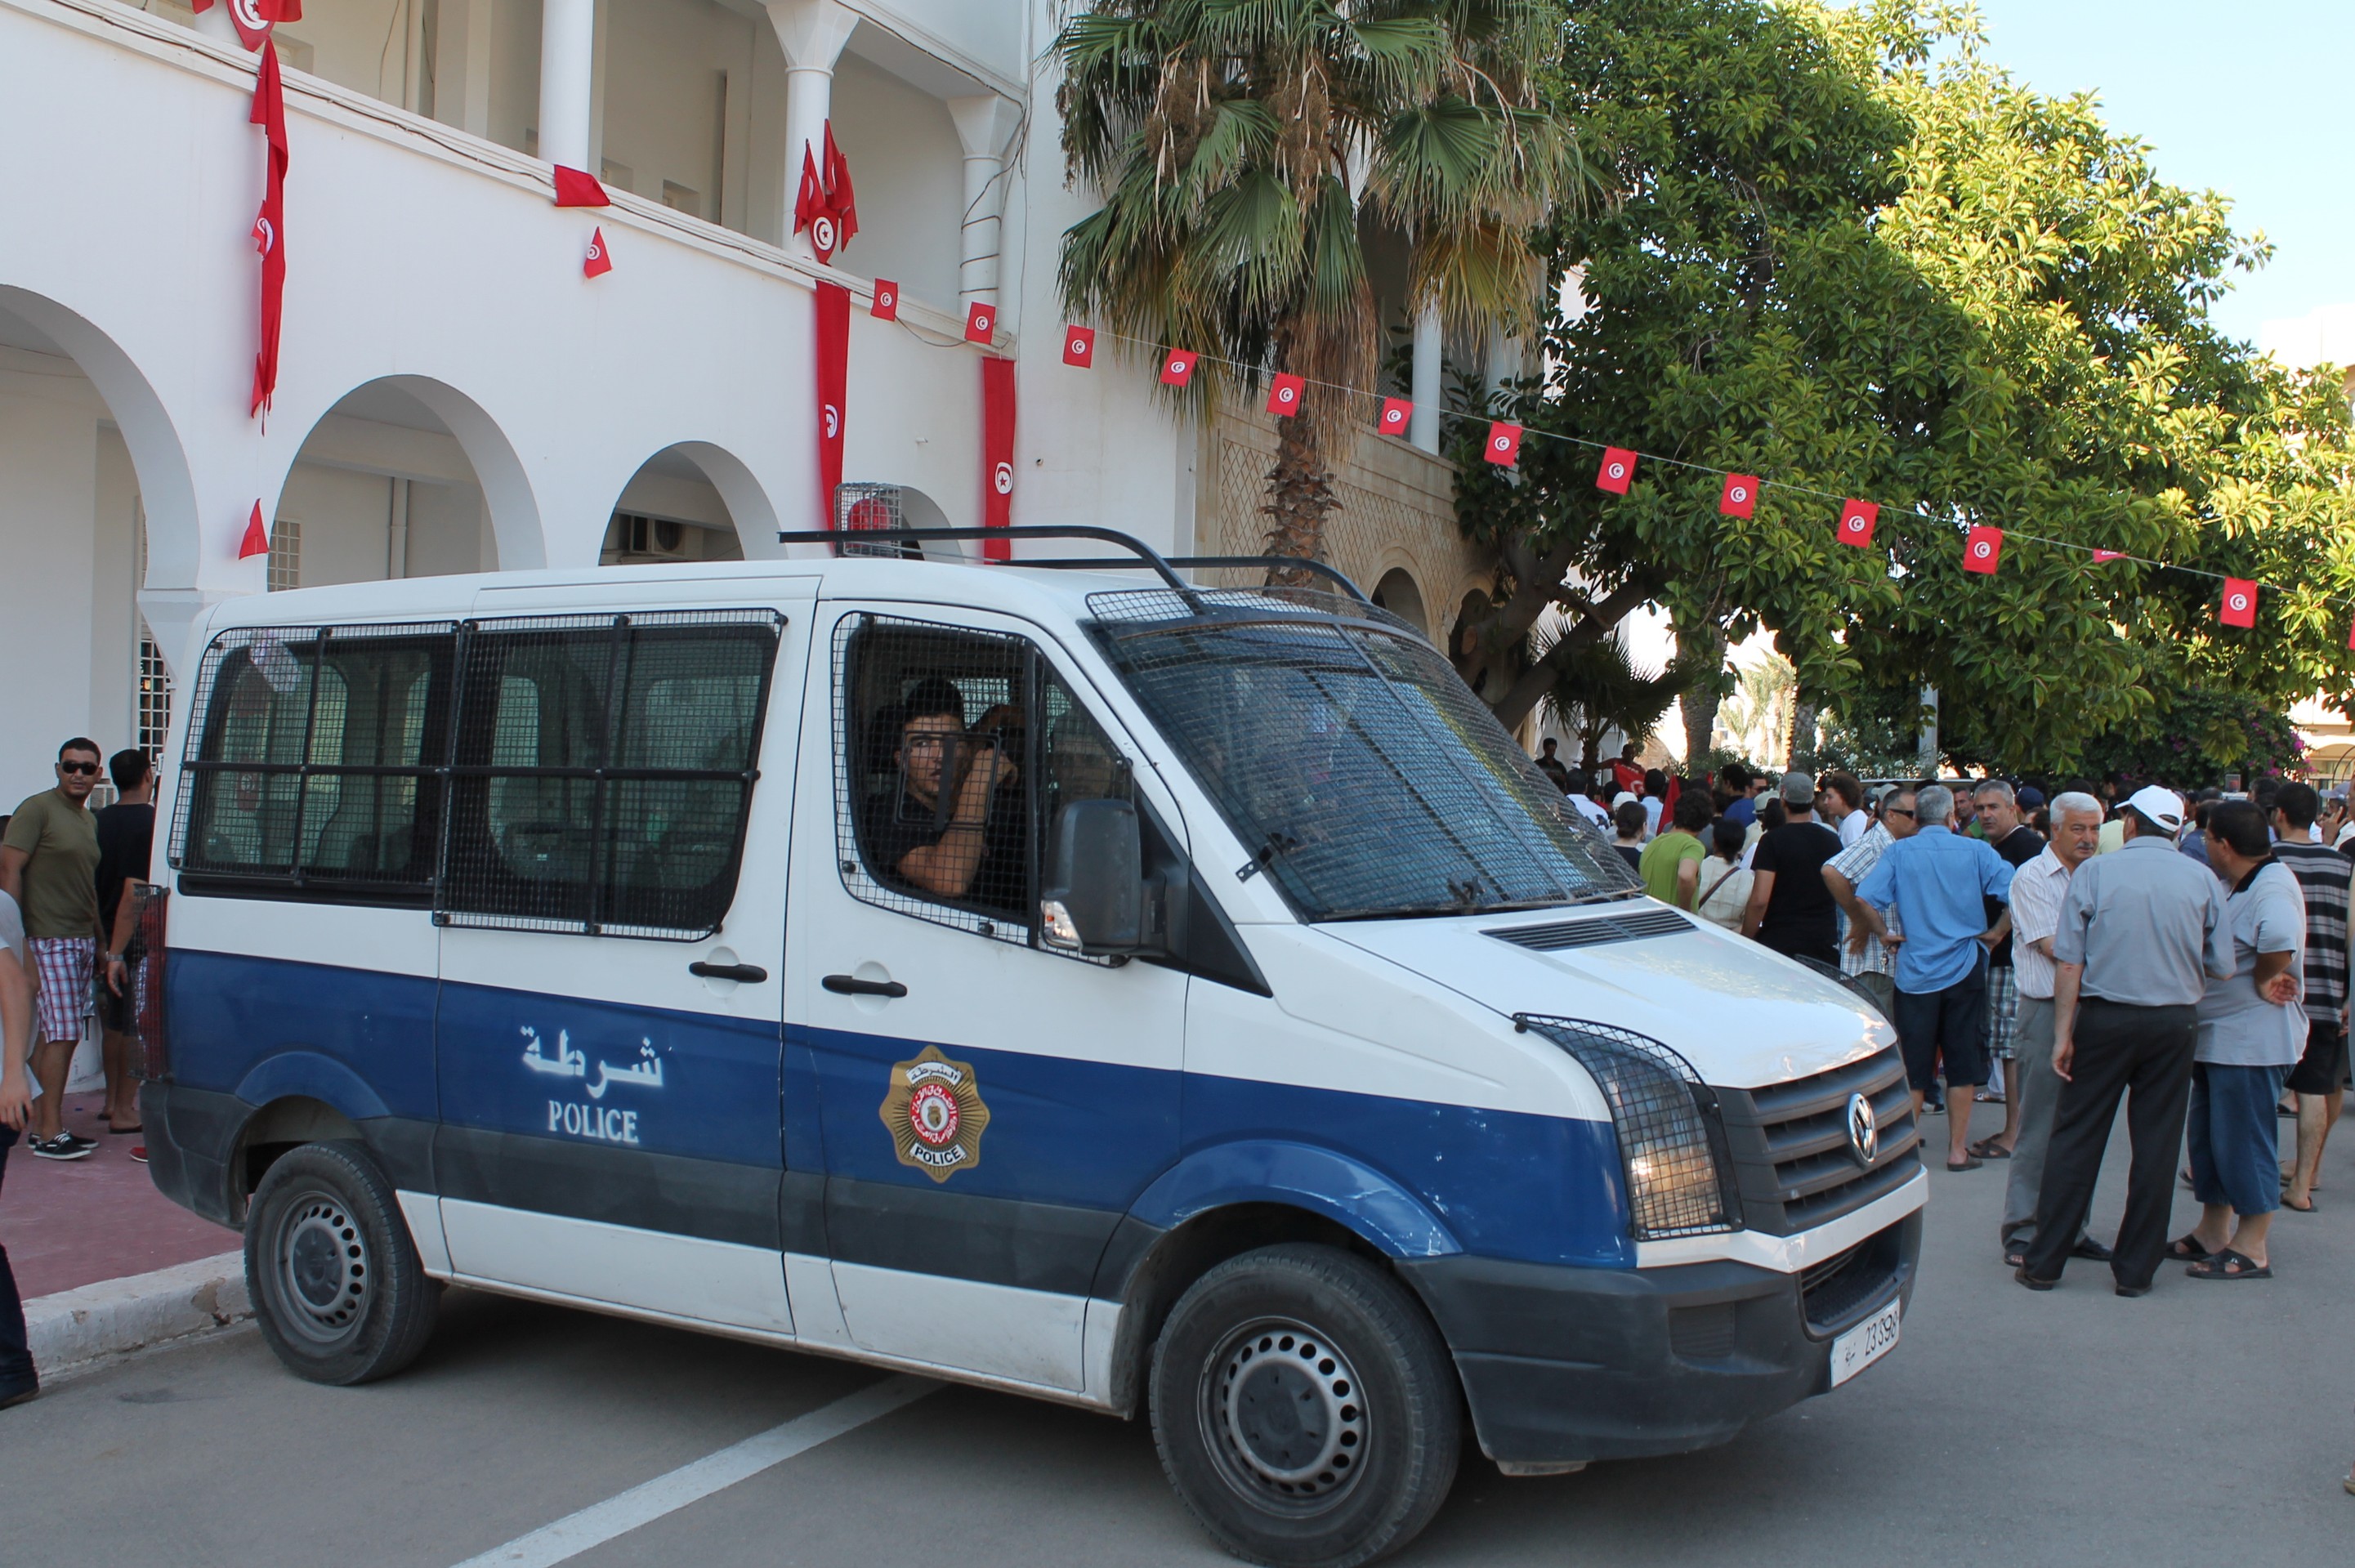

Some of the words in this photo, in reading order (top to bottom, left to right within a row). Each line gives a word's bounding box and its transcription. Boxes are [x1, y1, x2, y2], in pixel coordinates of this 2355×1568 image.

[520, 1025, 664, 1099] شرطة
[548, 1100, 639, 1143] POLICE
[914, 1146, 961, 1164] POLICE
